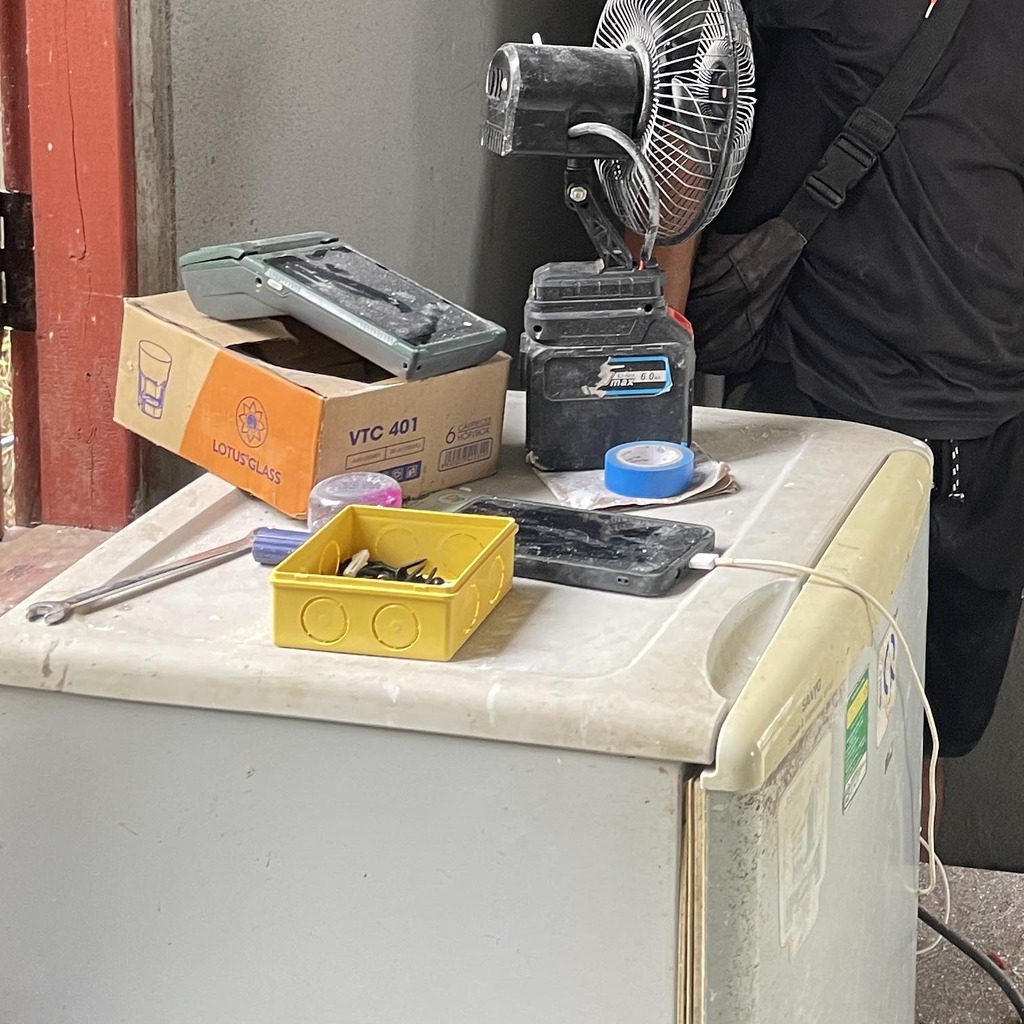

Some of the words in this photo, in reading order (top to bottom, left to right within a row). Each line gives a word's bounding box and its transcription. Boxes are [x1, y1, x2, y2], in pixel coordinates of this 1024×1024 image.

[610, 379, 633, 387] max
[349, 425, 384, 446] VTC
[389, 417, 417, 436] 401
[446, 426, 456, 444] 6
[212, 439, 246, 466] LOTUS
[248, 457, 282, 485] GLASS
